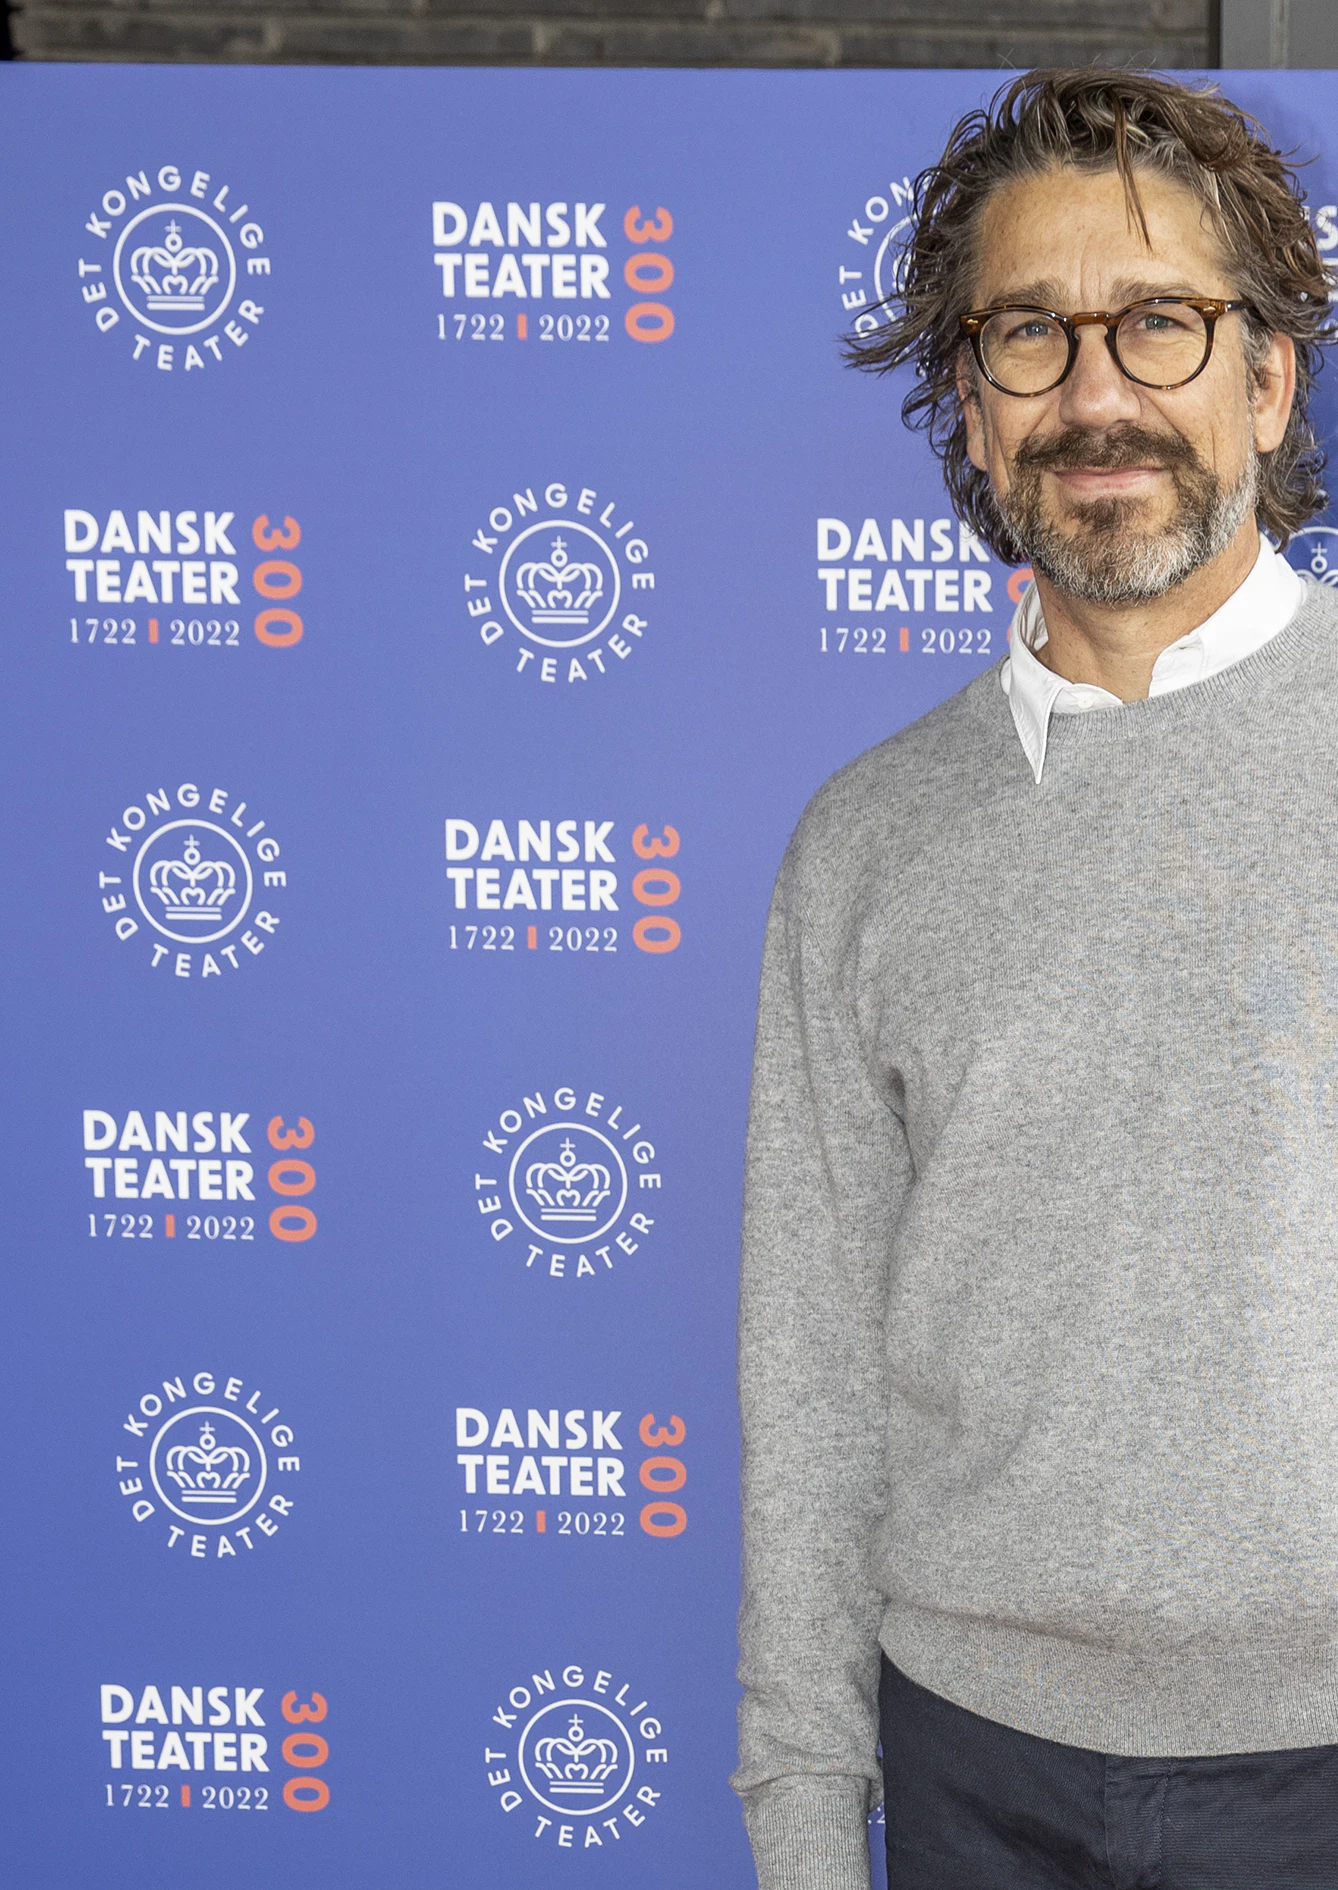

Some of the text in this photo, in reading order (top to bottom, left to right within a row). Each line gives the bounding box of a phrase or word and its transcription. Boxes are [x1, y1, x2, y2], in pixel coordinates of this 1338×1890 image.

[432, 201, 608, 248] DANSK
[78, 165, 271, 372] DET KONGELIGE TEATER
[433, 252, 611, 299] TEATER
[624, 206, 675, 342] 300
[438, 313, 610, 342] 1722 2022
[63, 509, 237, 555] DANSK
[816, 517, 990, 563] DANSK
[65, 558, 241, 605] TEATER
[252, 515, 303, 647] 300
[464, 482, 655, 683] DET KONGELIGE TEATER
[817, 568, 993, 612] TEATER
[70, 618, 240, 646] 1722 2022
[820, 627, 991, 654] 1722 2022
[444, 818, 616, 863] DANSK
[446, 867, 620, 912] TEATER
[632, 824, 681, 954] 300
[449, 925, 618, 952] 1722 2022
[82, 1109, 252, 1154] DANSK
[84, 1156, 256, 1201] TEATER
[267, 1115, 317, 1242] 300
[474, 1087, 662, 1278] DET KONGELIGE TEATER
[88, 1213, 255, 1241] 1722 2022
[116, 1371, 301, 1559] DET KONGELIGE TEATER
[100, 1684, 266, 1727] DANSK
[101, 1729, 270, 1773] TEATER
[281, 1691, 329, 1812] 300
[106, 1783, 269, 1811] 1722 2022
